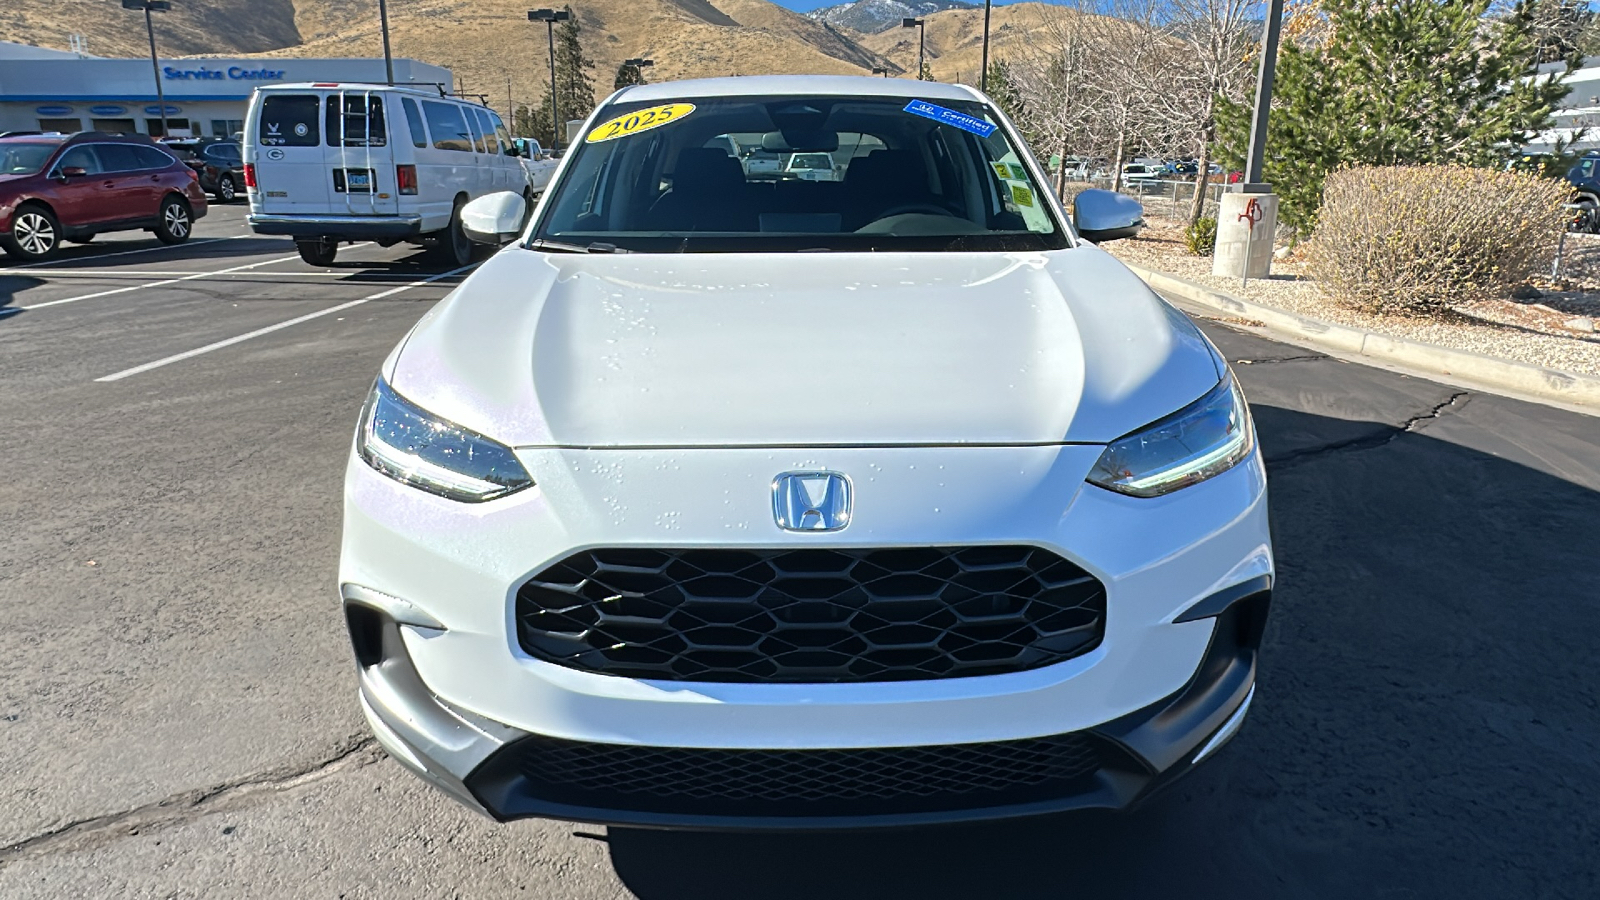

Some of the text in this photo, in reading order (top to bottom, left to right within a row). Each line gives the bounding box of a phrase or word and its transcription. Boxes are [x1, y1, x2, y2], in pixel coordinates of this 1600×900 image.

[163, 66, 286, 80] Service Center
[604, 105, 674, 139] 2025
[943, 111, 990, 130] Certified
